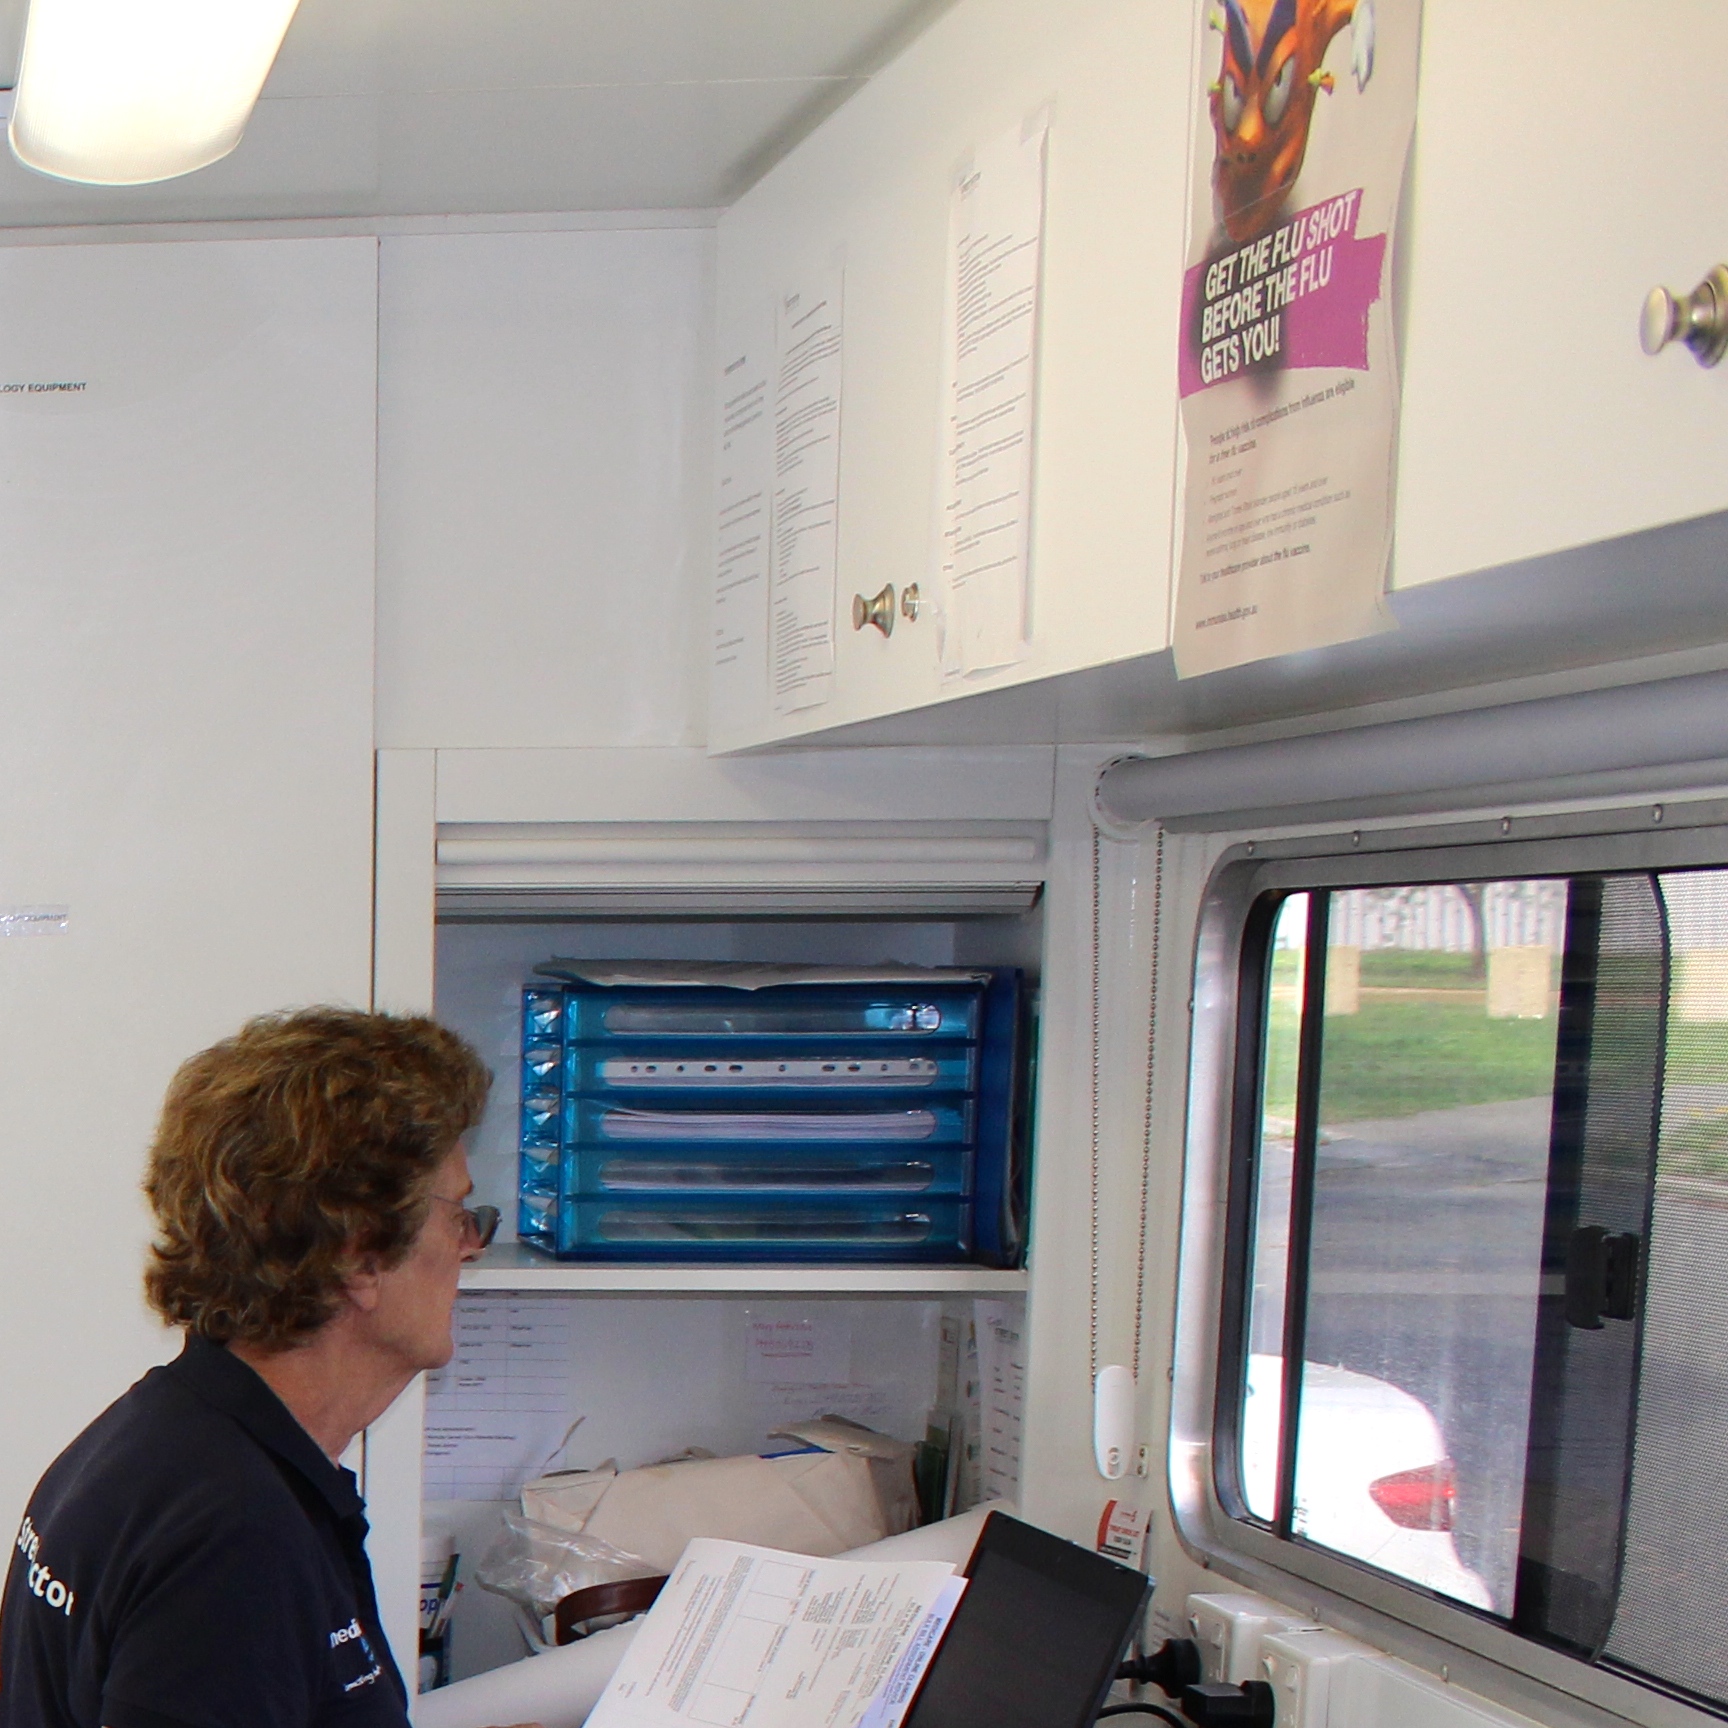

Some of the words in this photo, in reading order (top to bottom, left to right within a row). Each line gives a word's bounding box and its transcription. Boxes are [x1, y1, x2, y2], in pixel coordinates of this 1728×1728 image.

[1205, 253, 1238, 301] GET
[1239, 236, 1272, 283] THE
[1271, 217, 1307, 268] FLU
[1306, 191, 1357, 250] SHOT
[1202, 280, 1262, 343] BEFORE
[1266, 264, 1297, 312] THE
[1299, 246, 1333, 296] FLU
[1201, 334, 1240, 384] GETS
[1242, 314, 1279, 365] YOU!
[28, 383, 86, 392] EQUIPMENT
[1335, 378, 1354, 395] eligible
[18, 1517, 39, 1563] Stre
[29, 1562, 74, 1616] ctor
[923, 1618, 943, 1646] MEDICARE
